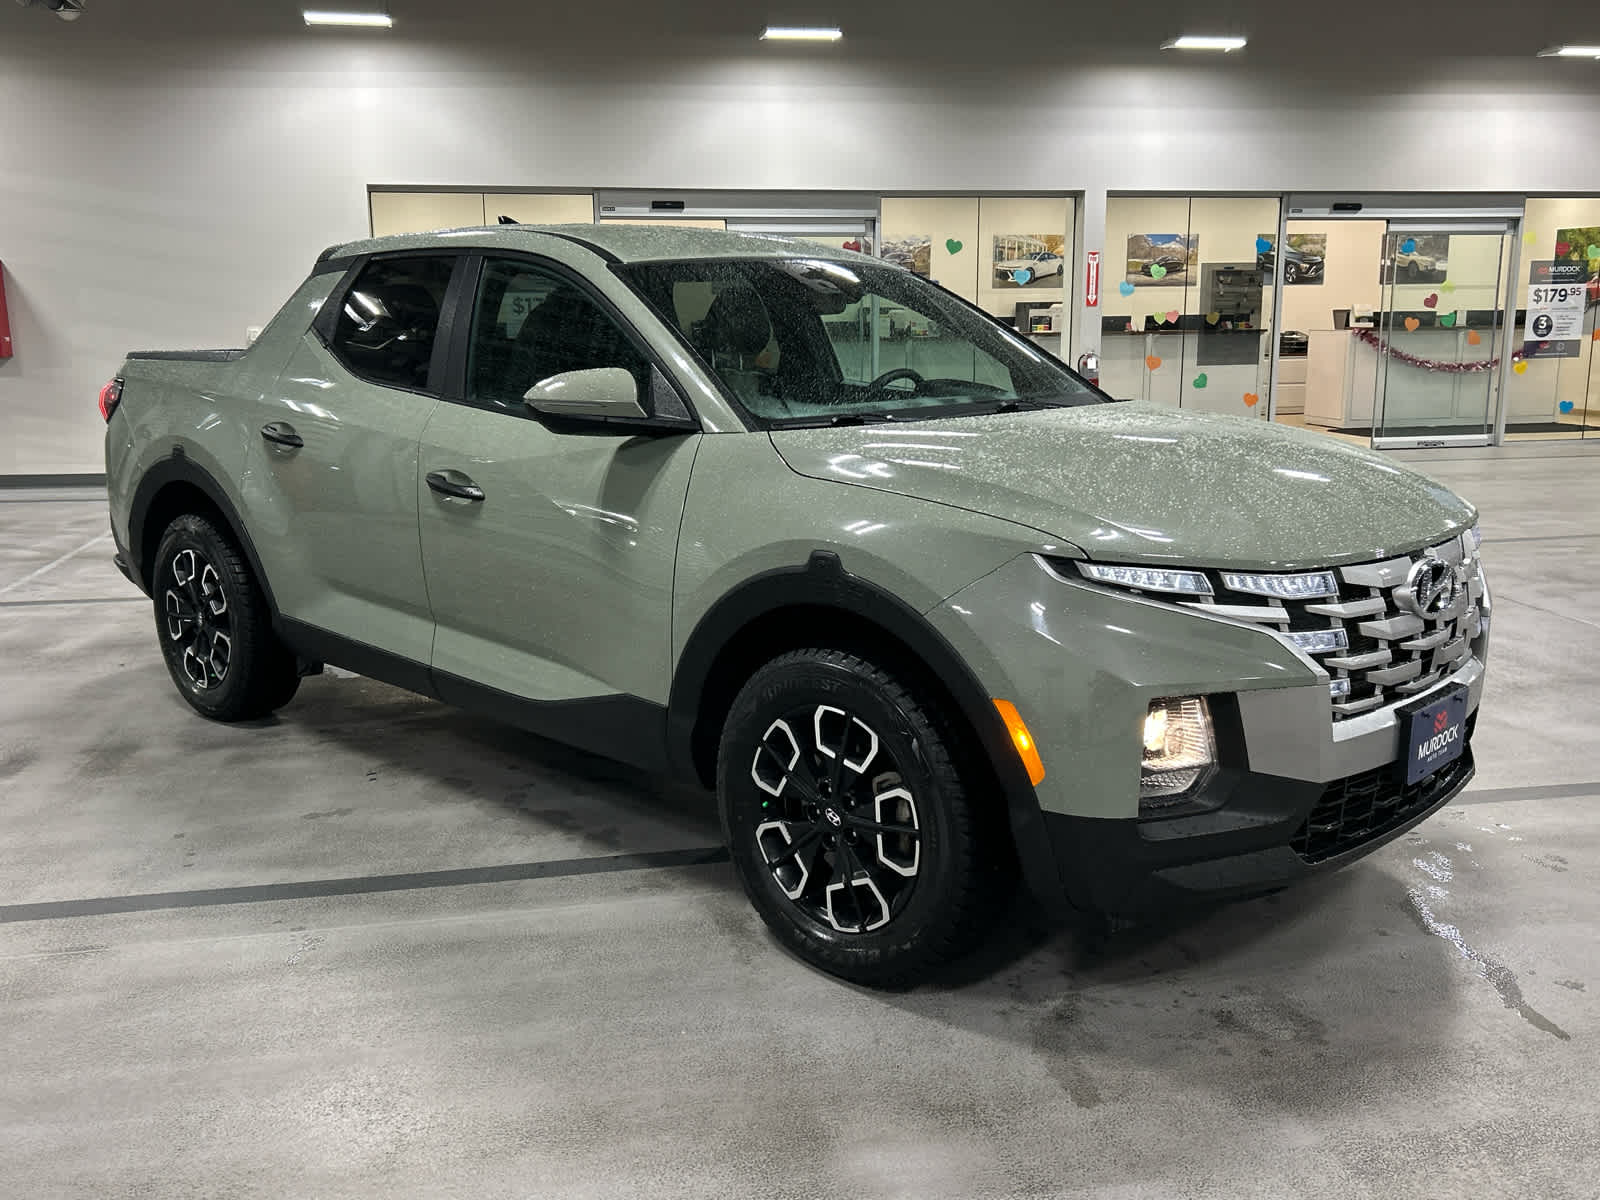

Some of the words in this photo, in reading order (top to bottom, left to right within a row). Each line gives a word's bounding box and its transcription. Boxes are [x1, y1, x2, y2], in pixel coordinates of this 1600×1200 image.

[1533, 287, 1582, 304] $179.95
[1538, 316, 1547, 329] 3
[1417, 723, 1459, 760] MURDOCK
